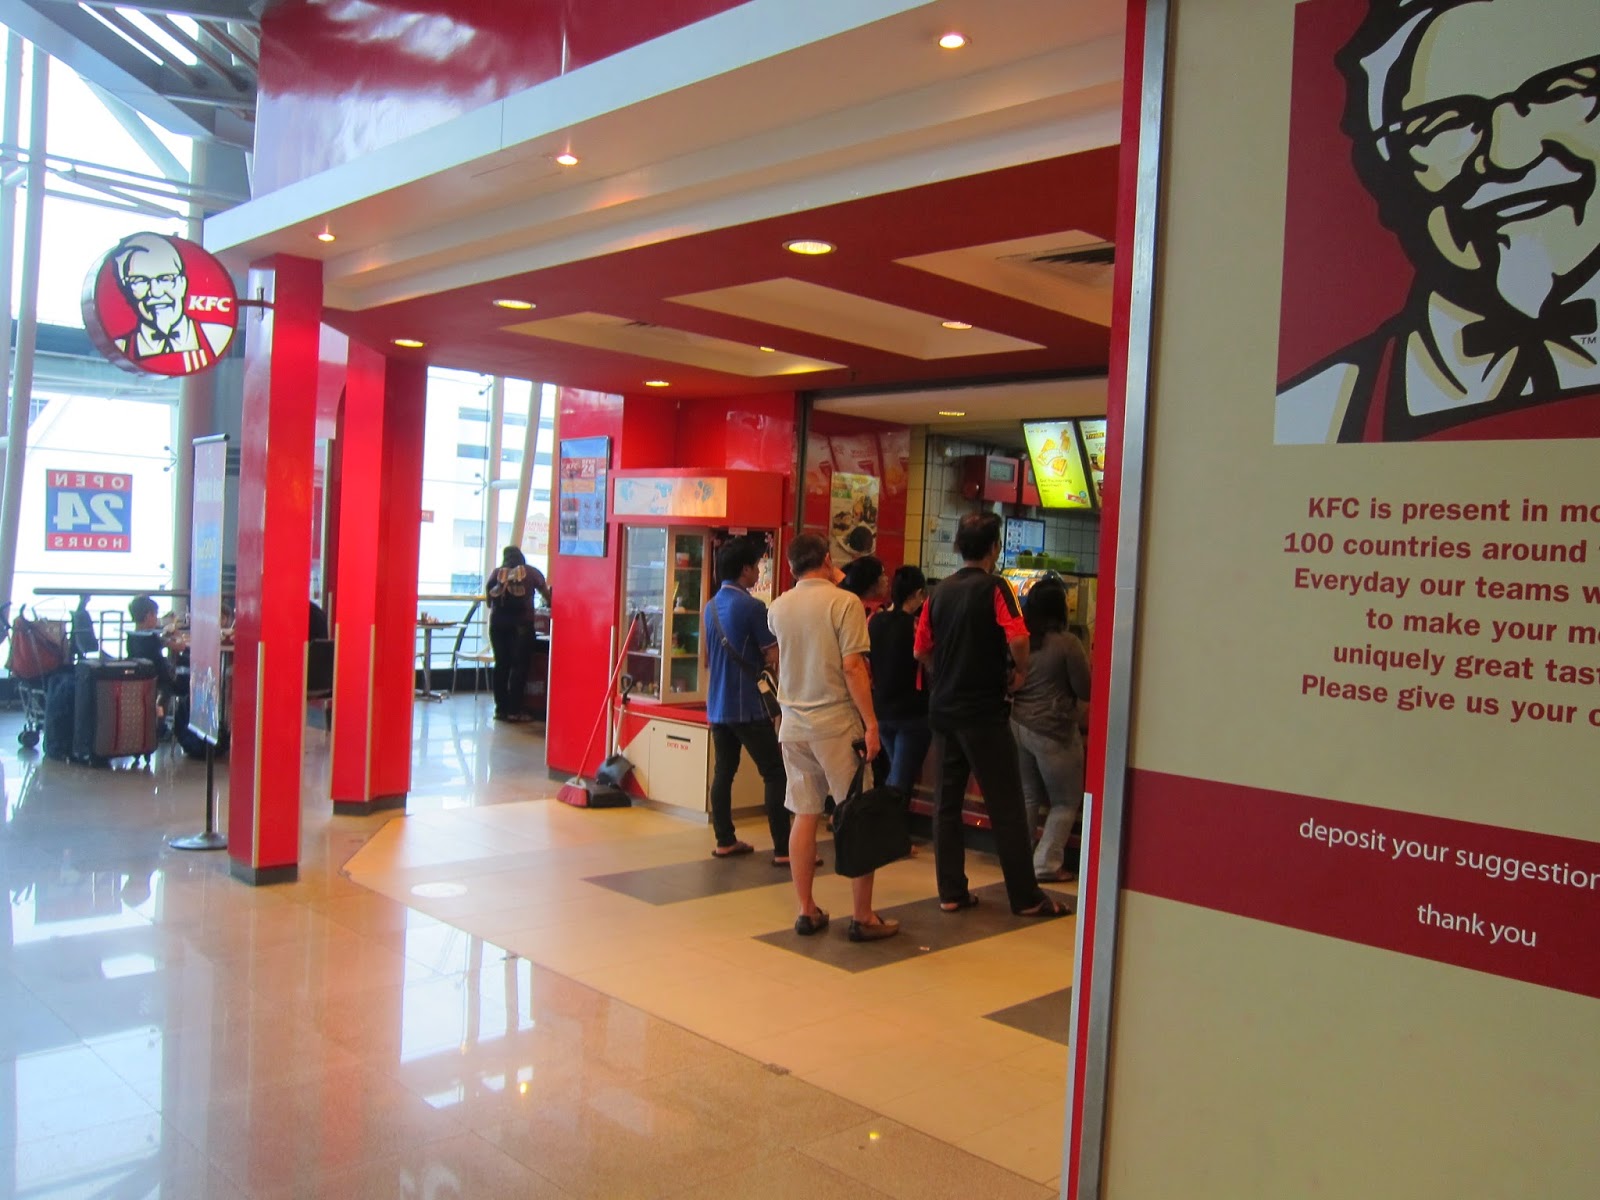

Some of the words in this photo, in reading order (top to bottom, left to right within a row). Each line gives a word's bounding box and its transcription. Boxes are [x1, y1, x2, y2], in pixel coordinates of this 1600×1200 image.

[188, 295, 231, 313] KFC
[1309, 498, 1359, 518] KFC
[1370, 498, 1391, 519] is
[1402, 499, 1510, 524] present
[1522, 498, 1548, 522] in
[1284, 533, 1333, 554] 100
[1343, 536, 1471, 559] countries
[1482, 540, 1587, 563] around
[1295, 568, 1410, 598] Everyday
[1420, 579, 1465, 596] our
[1475, 576, 1569, 602] teams
[1366, 608, 1393, 630] to
[1404, 612, 1480, 636] make
[1491, 621, 1557, 643] your
[1334, 644, 1445, 676] uniquely
[1454, 655, 1533, 680] great
[1302, 674, 1388, 703] Please
[1397, 685, 1455, 711] give
[1467, 696, 1499, 715] us
[1511, 700, 1577, 723] your
[1300, 818, 1385, 851] deposit
[1392, 839, 1449, 862] your
[1418, 904, 1484, 936] thank
[1490, 923, 1536, 946] you
